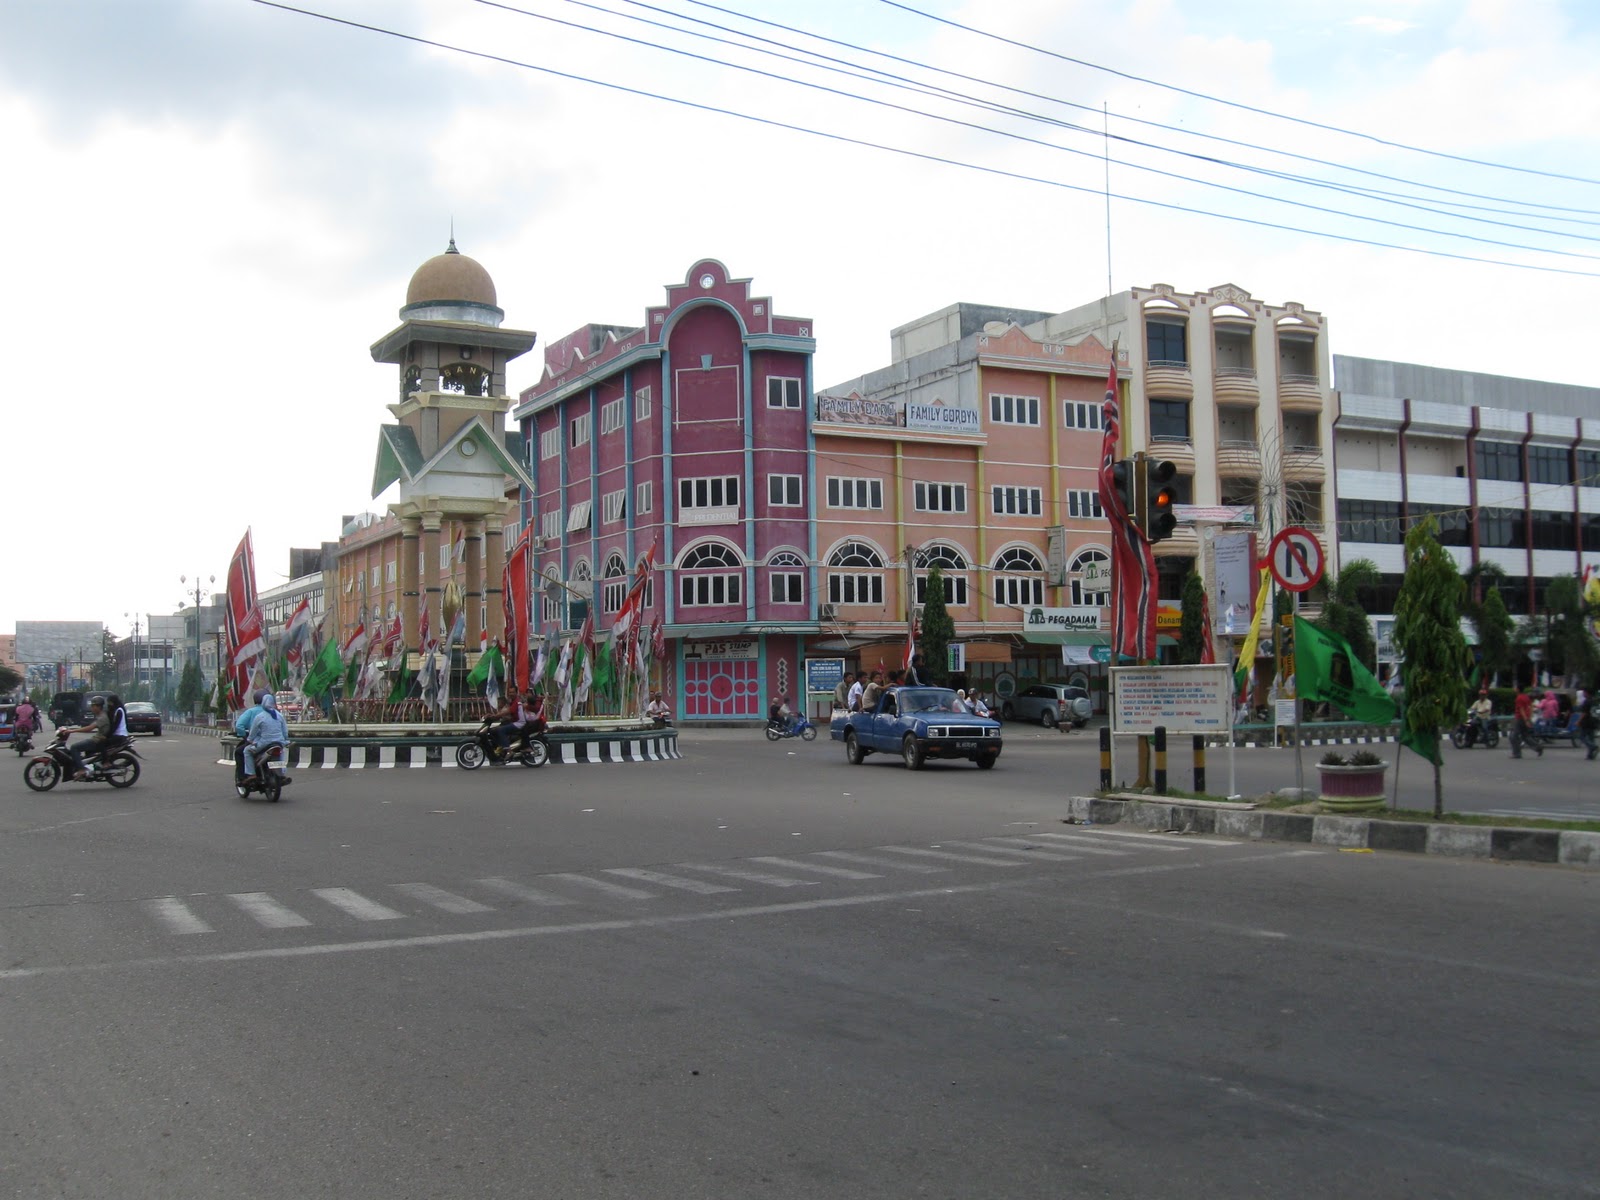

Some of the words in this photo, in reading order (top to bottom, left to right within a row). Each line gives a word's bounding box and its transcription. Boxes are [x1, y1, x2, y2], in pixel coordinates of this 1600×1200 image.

[822, 398, 862, 414] FAMILY
[910, 405, 940, 421] FAMILY
[943, 408, 978, 425] GORDYN
[1048, 615, 1097, 624] PEGADAIAN
[1158, 616, 1182, 624] Danam
[705, 644, 726, 654] PAS
